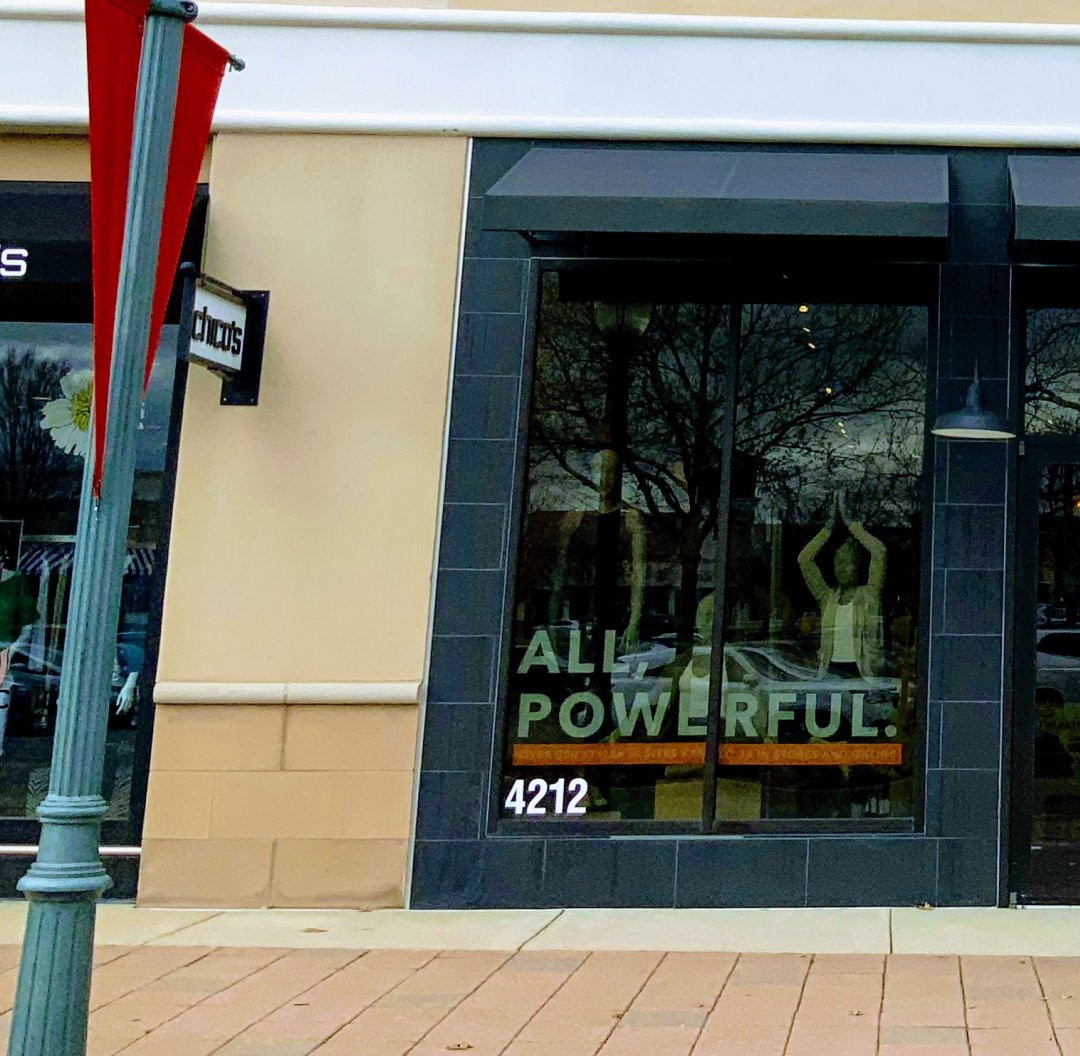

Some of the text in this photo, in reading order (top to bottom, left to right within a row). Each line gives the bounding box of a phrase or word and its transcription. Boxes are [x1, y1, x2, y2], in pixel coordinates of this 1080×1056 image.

[517, 629, 649, 681] ALL,
[517, 691, 898, 739] POWERFUL.
[504, 777, 589, 816] 4212
